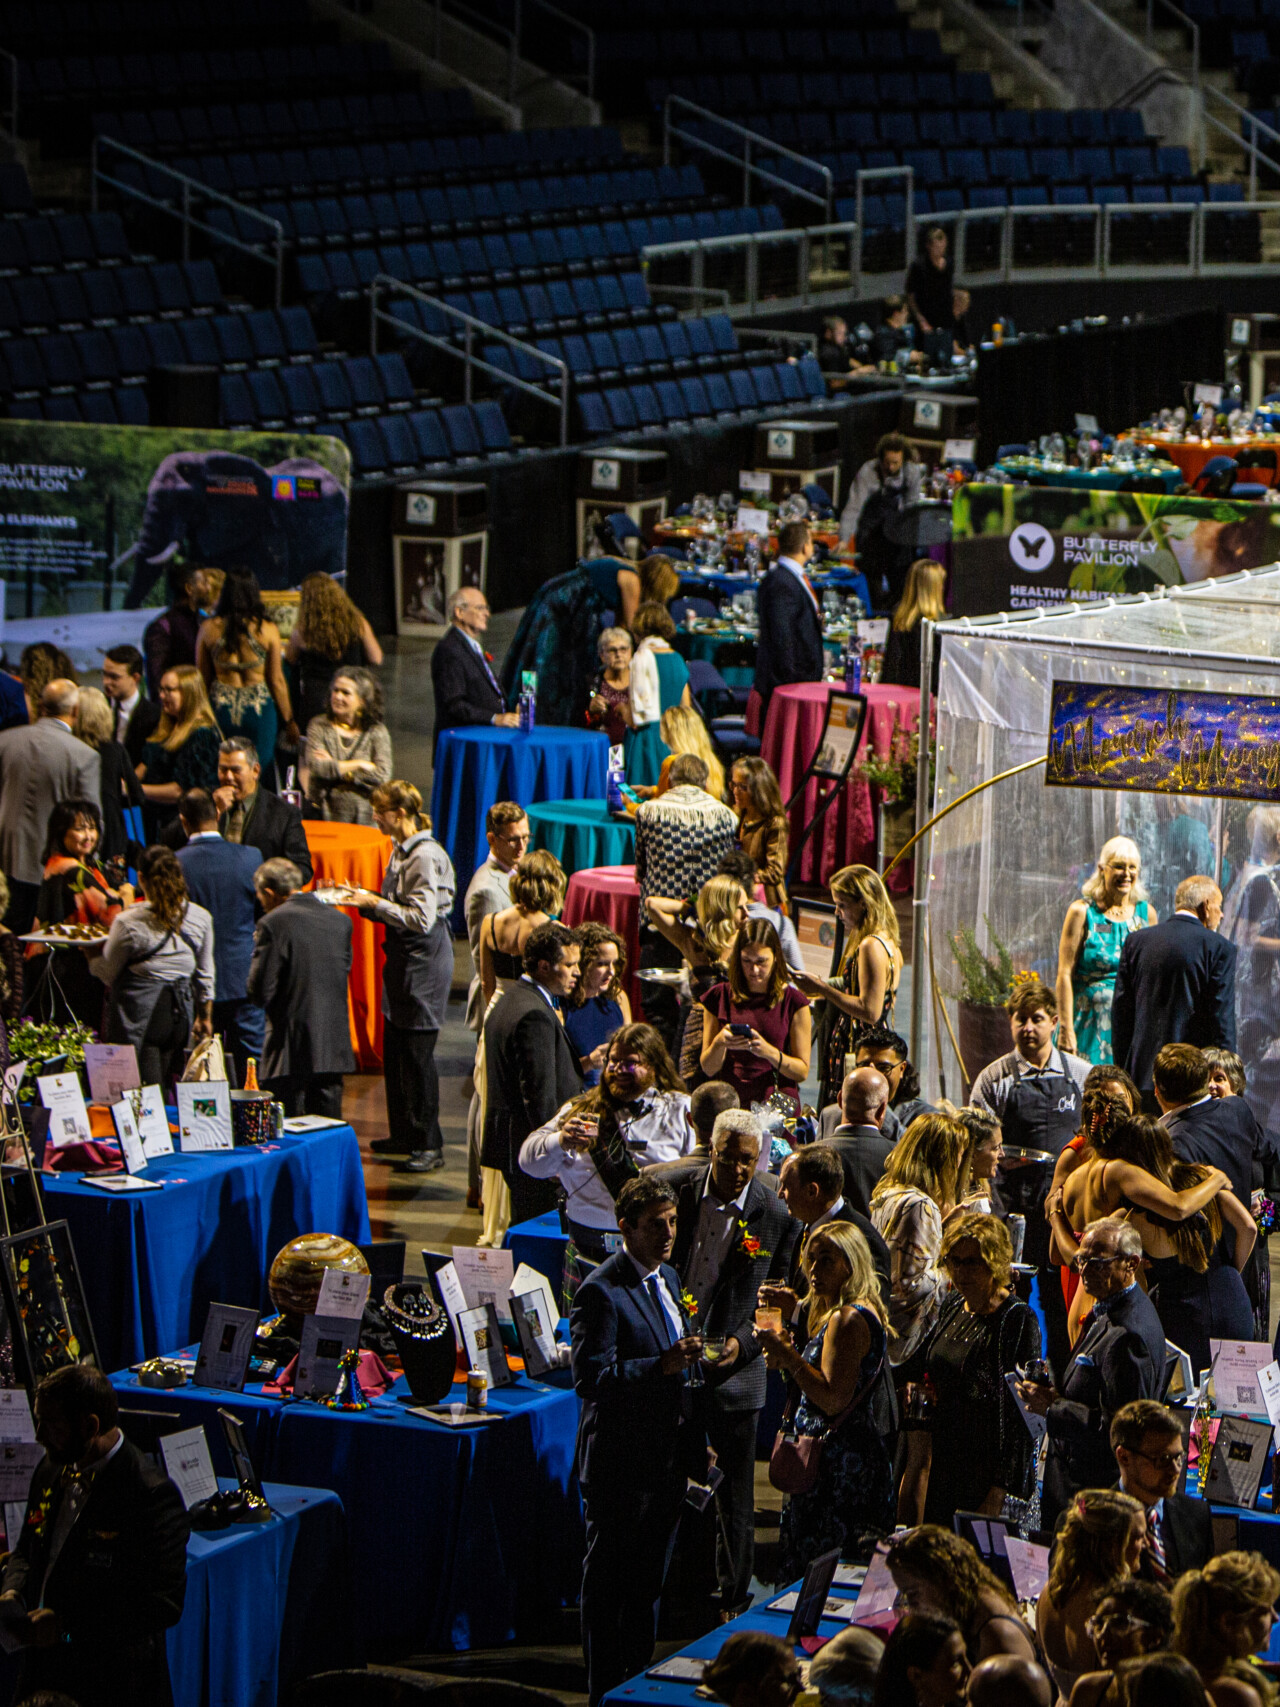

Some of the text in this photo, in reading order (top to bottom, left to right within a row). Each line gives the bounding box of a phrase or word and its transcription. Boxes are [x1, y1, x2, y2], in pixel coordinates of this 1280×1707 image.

[6, 513, 78, 529] ELEPHANTS
[1063, 536, 1158, 553] BUTTERFLY
[1063, 551, 1138, 566] PAVILION
[1010, 585, 1134, 600] HEALTHY HABITAT
